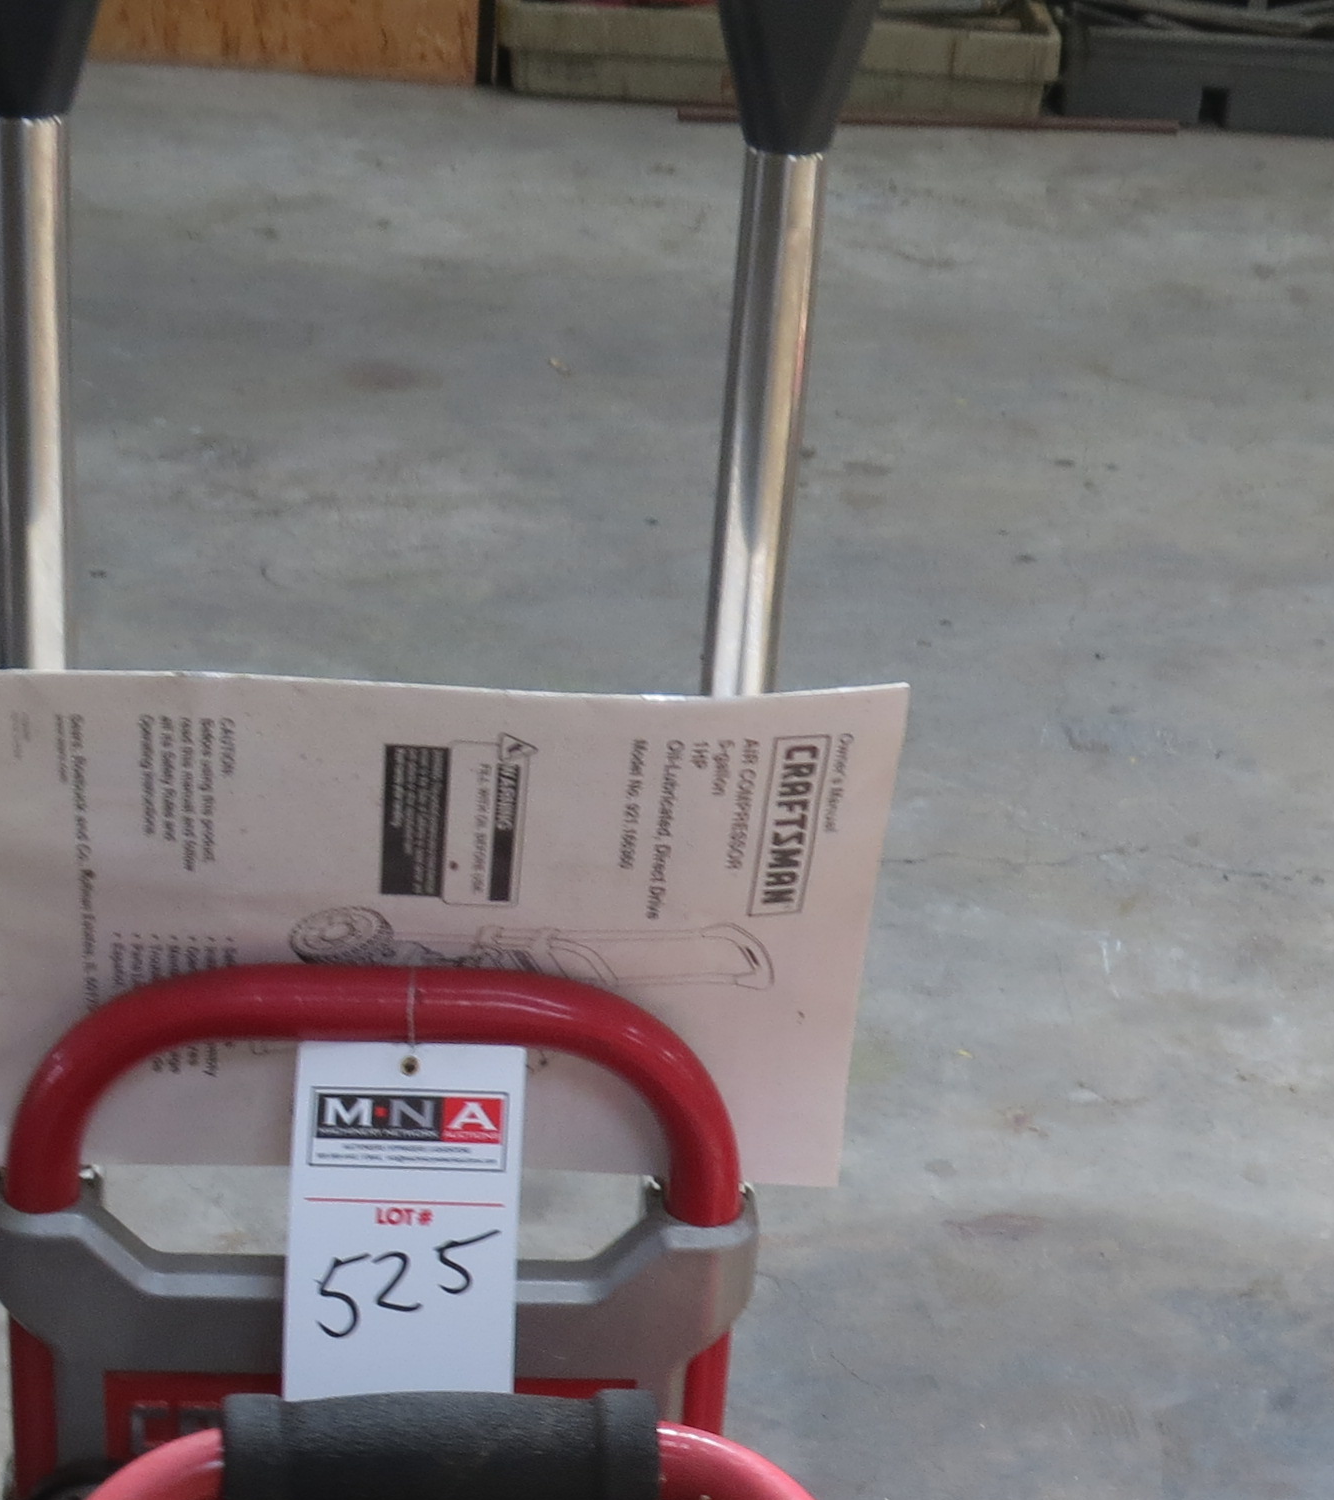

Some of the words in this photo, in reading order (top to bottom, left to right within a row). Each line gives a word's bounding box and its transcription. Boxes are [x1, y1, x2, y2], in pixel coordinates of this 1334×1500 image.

[629, 739, 649, 776] Model
[711, 739, 735, 796] 5-gallon
[740, 738, 760, 765] AIR
[496, 764, 518, 830] WARNING
[725, 769, 757, 870] COMPRESSOR
[824, 787, 844, 833] Manual
[762, 745, 820, 904] CRAFTSMAN
[649, 844, 672, 882] Direct
[646, 886, 666, 920] Drive
[375, 1207, 414, 1226] LOT
[418, 1208, 435, 1225] #
[314, 1229, 502, 1338] 525
